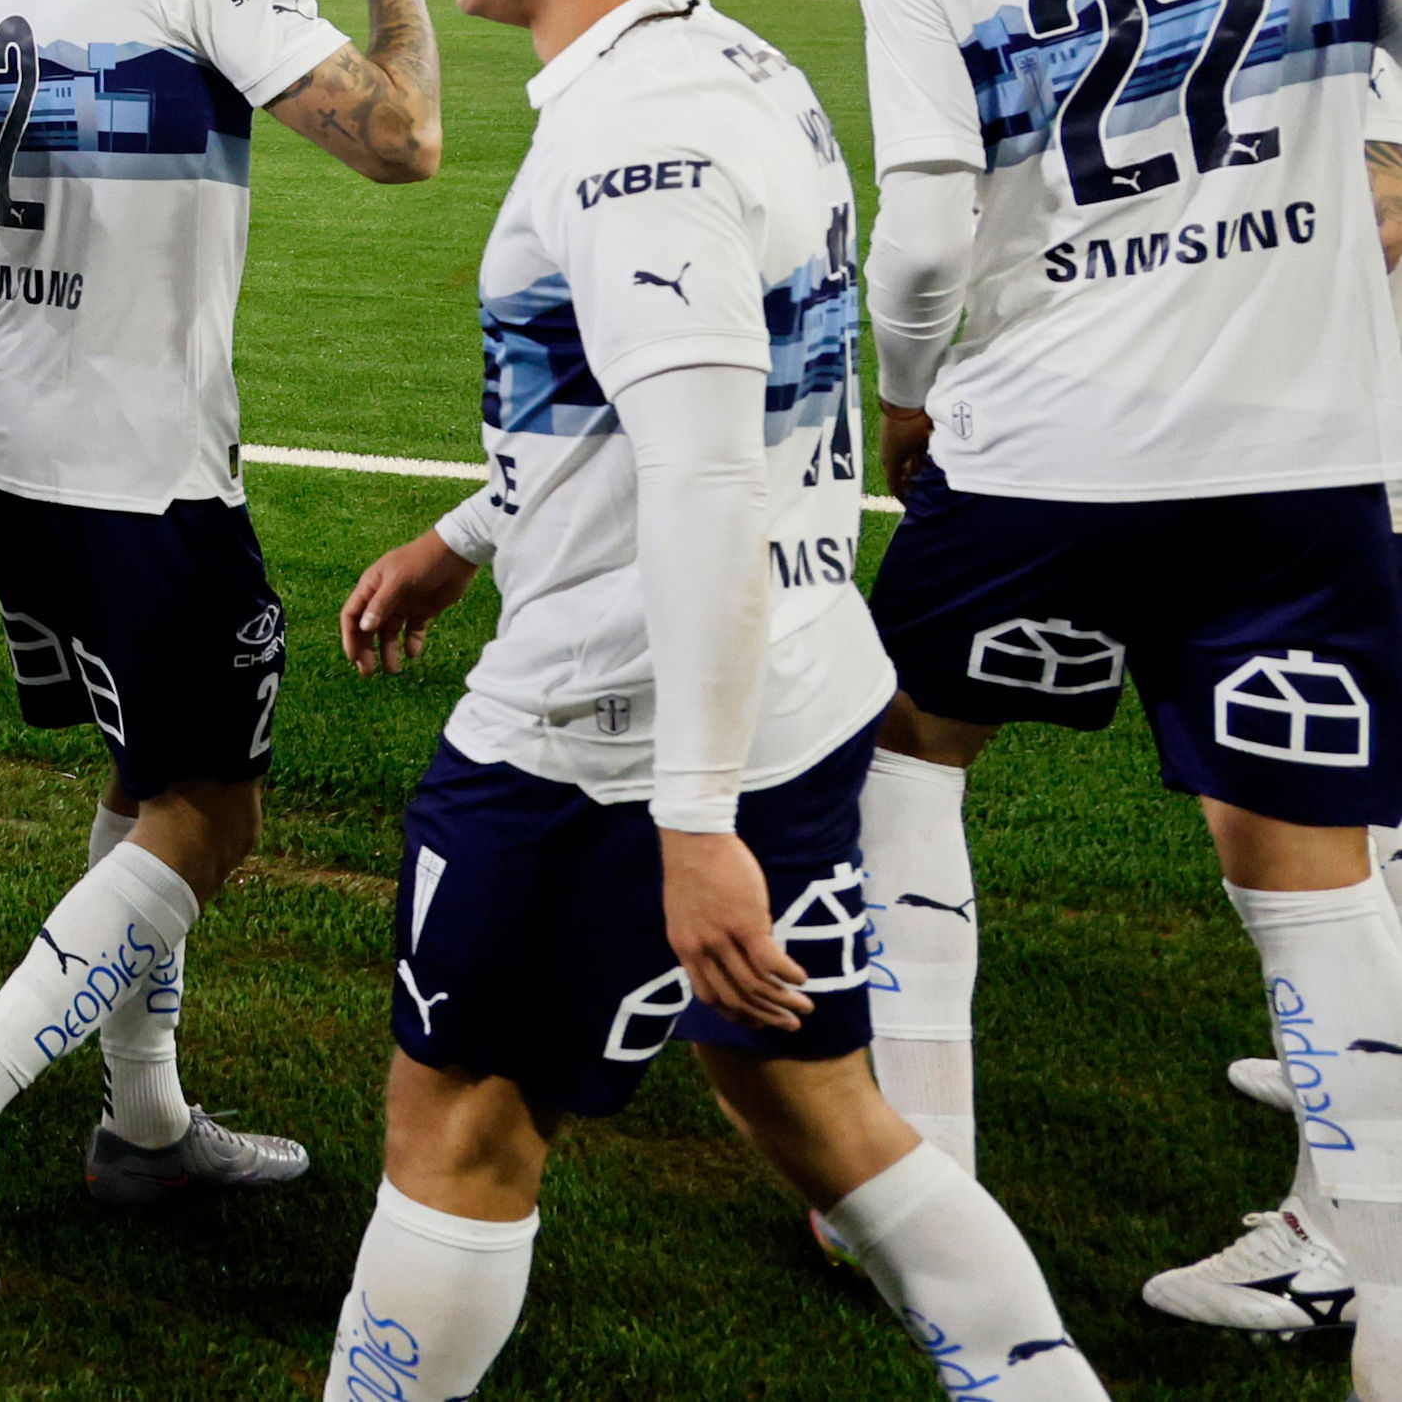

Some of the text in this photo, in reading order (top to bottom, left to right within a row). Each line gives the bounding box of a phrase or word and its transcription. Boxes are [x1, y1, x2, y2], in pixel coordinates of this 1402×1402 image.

[576, 160, 713, 210] 1XBET
[1044, 200, 1318, 284] SAMSUNG
[249, 671, 280, 760] 2
